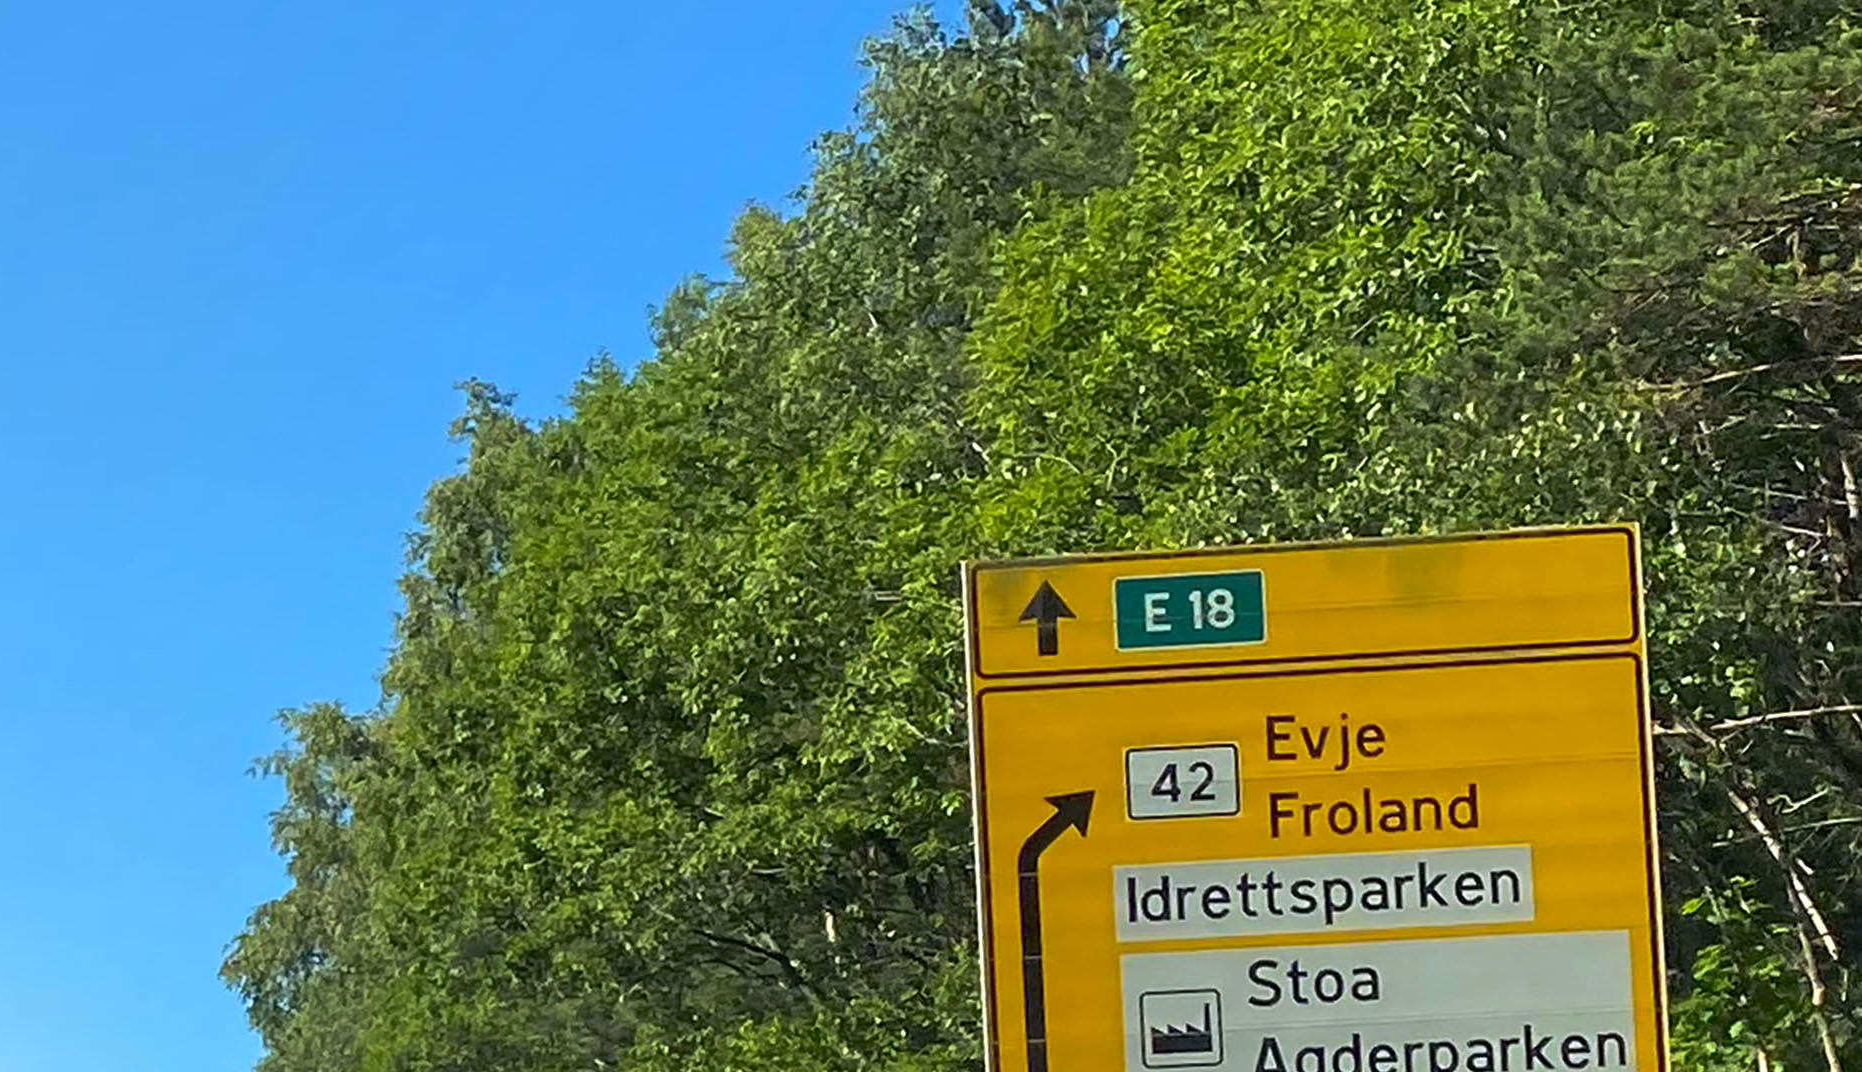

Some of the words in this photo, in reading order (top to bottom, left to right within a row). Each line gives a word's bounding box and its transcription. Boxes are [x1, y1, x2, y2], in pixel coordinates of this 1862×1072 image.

[1144, 592, 1172, 632] E
[1188, 588, 1235, 630] 18
[1265, 713, 1386, 773] Evje
[1151, 761, 1216, 803] 42
[1269, 783, 1479, 839] Froland
[1127, 861, 1520, 926] Idrettsparken
[1248, 959, 1381, 1007] Stoa
